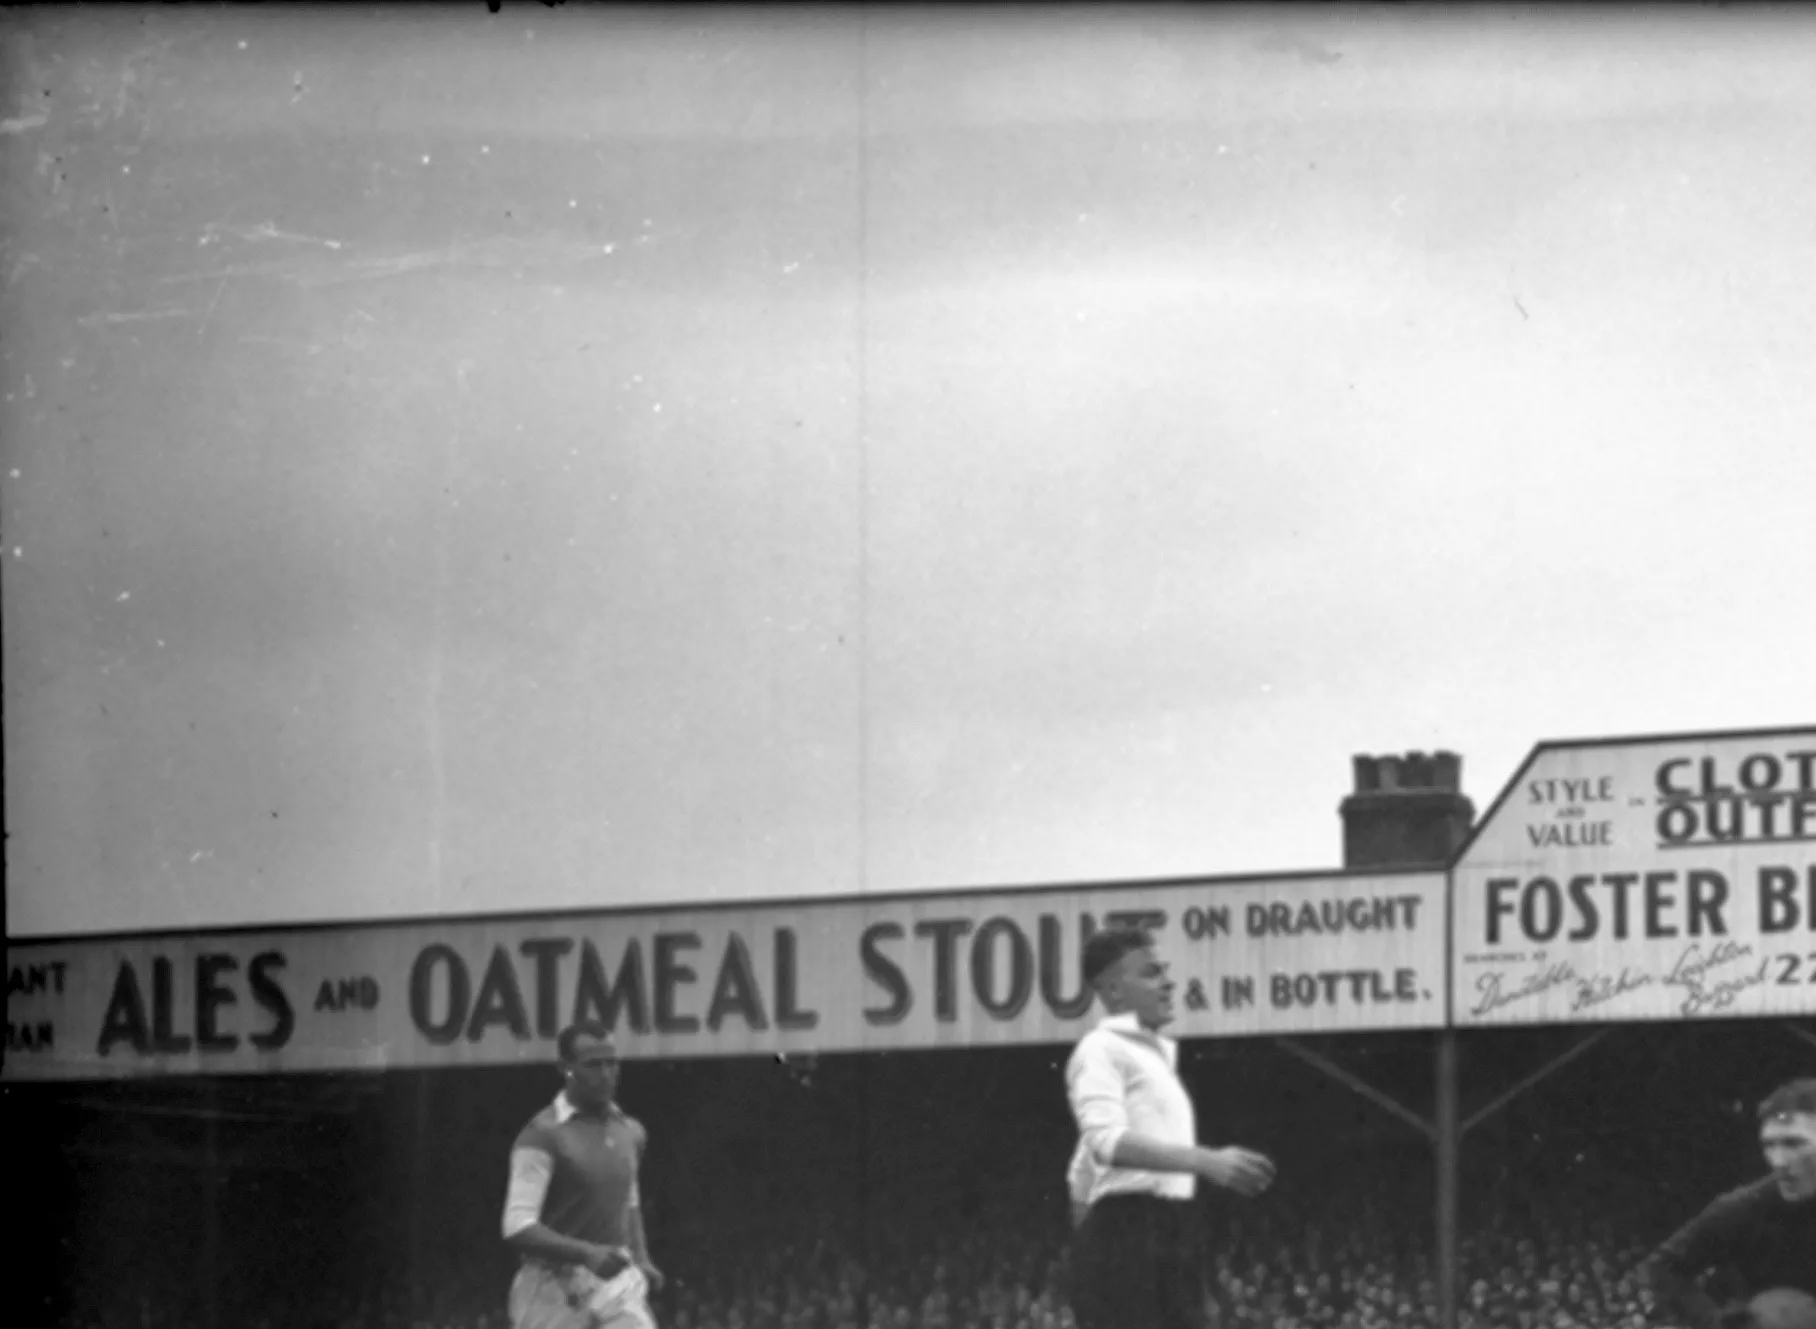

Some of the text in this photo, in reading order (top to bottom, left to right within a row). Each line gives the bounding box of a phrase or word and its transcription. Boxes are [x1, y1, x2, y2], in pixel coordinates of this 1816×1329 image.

[1527, 776, 1613, 808] STYLE
[1526, 819, 1613, 849] VALUE
[1182, 895, 1423, 941] ON DRAUGHT
[1485, 868, 1730, 946] FOSTER
[96, 949, 297, 1058] ALES
[314, 975, 380, 1014] AND
[407, 928, 819, 1048] OATMEAL
[1183, 976, 1210, 1011] &
[1221, 973, 1255, 1010] IN
